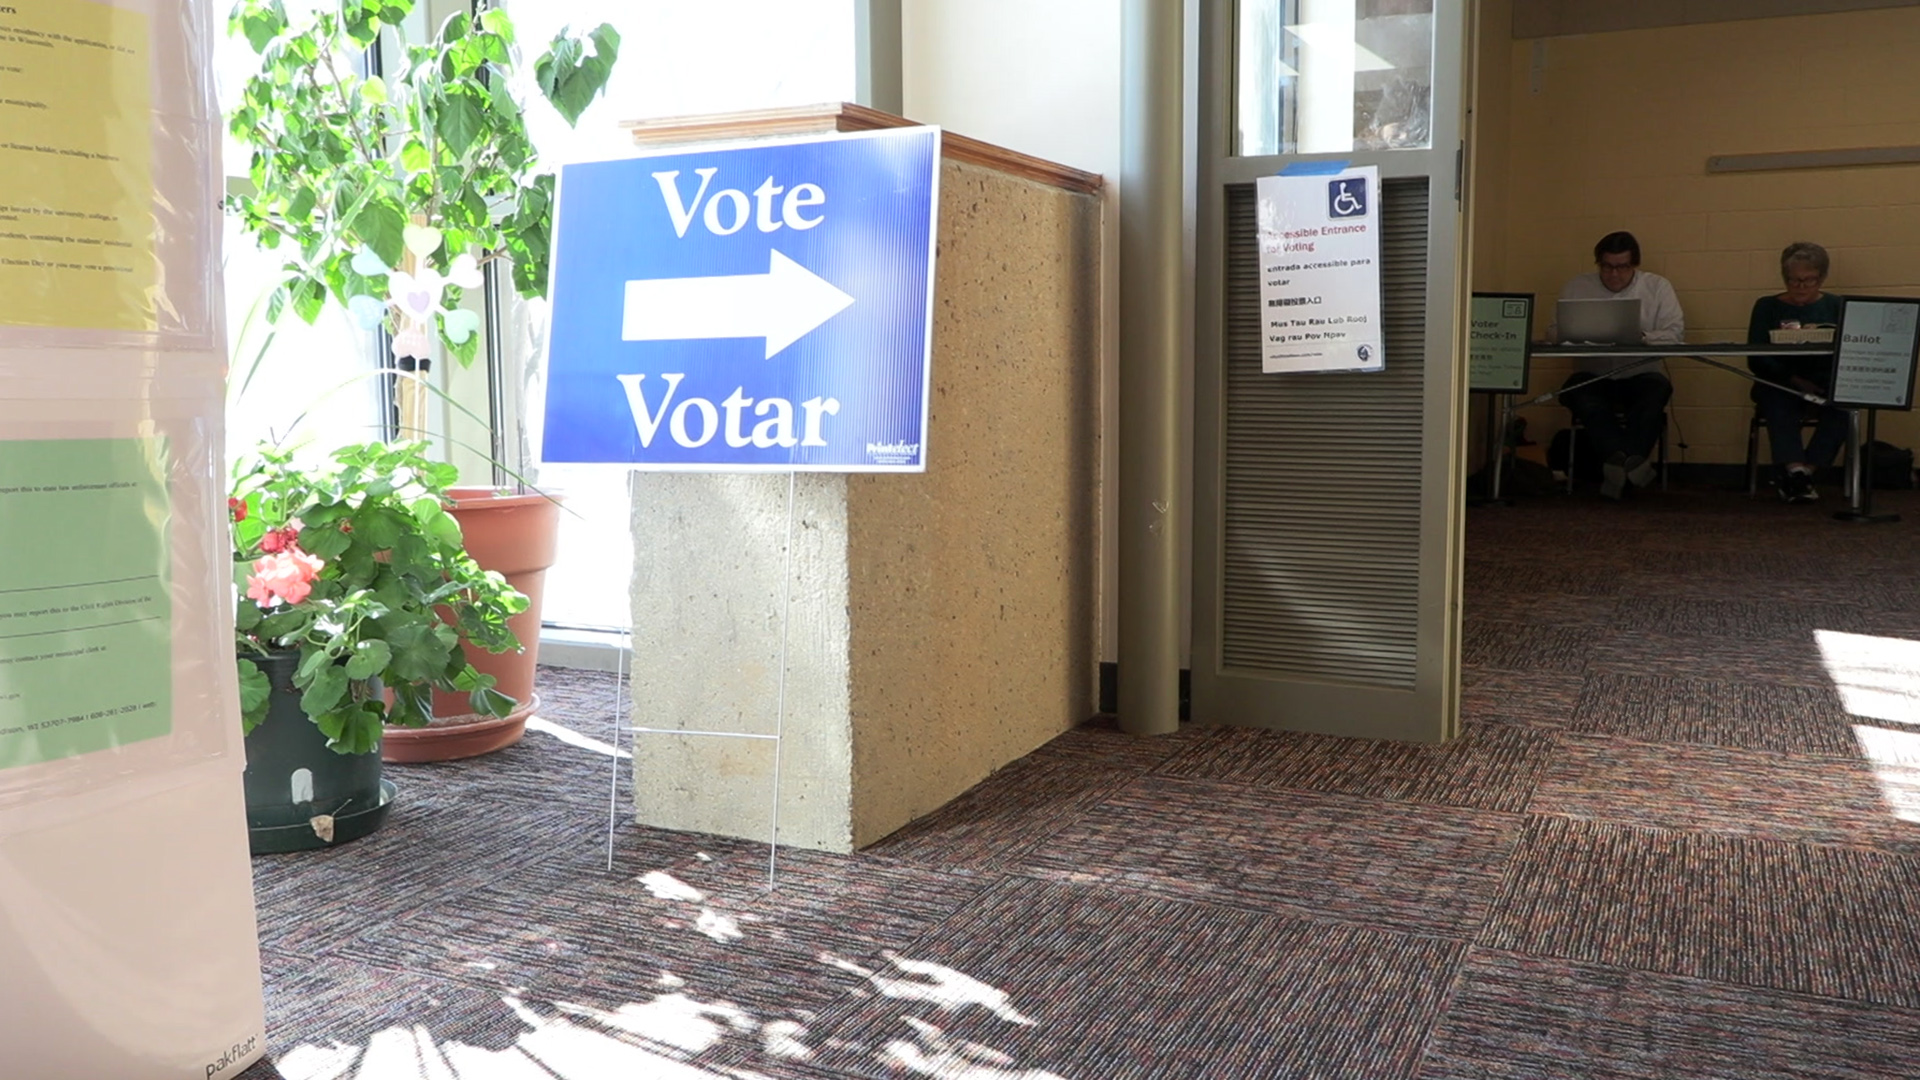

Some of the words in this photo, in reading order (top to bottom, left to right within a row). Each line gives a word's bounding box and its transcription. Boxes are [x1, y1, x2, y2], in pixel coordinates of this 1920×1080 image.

[651, 167, 826, 239] Vote
[1321, 225, 1366, 236] Entrance
[1283, 242, 1315, 253] Voting
[1267, 263, 1301, 273] entrada
[1303, 259, 1348, 270] accessible
[1350, 258, 1371, 268] para
[1270, 320, 1288, 328] Mus
[1471, 320, 1499, 328] Voter
[1269, 334, 1286, 343] Vag
[1304, 332, 1321, 340] Pov
[1470, 331, 1517, 340] Check-In
[1843, 334, 1882, 345] Ballot
[616, 373, 840, 449] Votar
[206, 1036, 256, 1080] pakflatt
